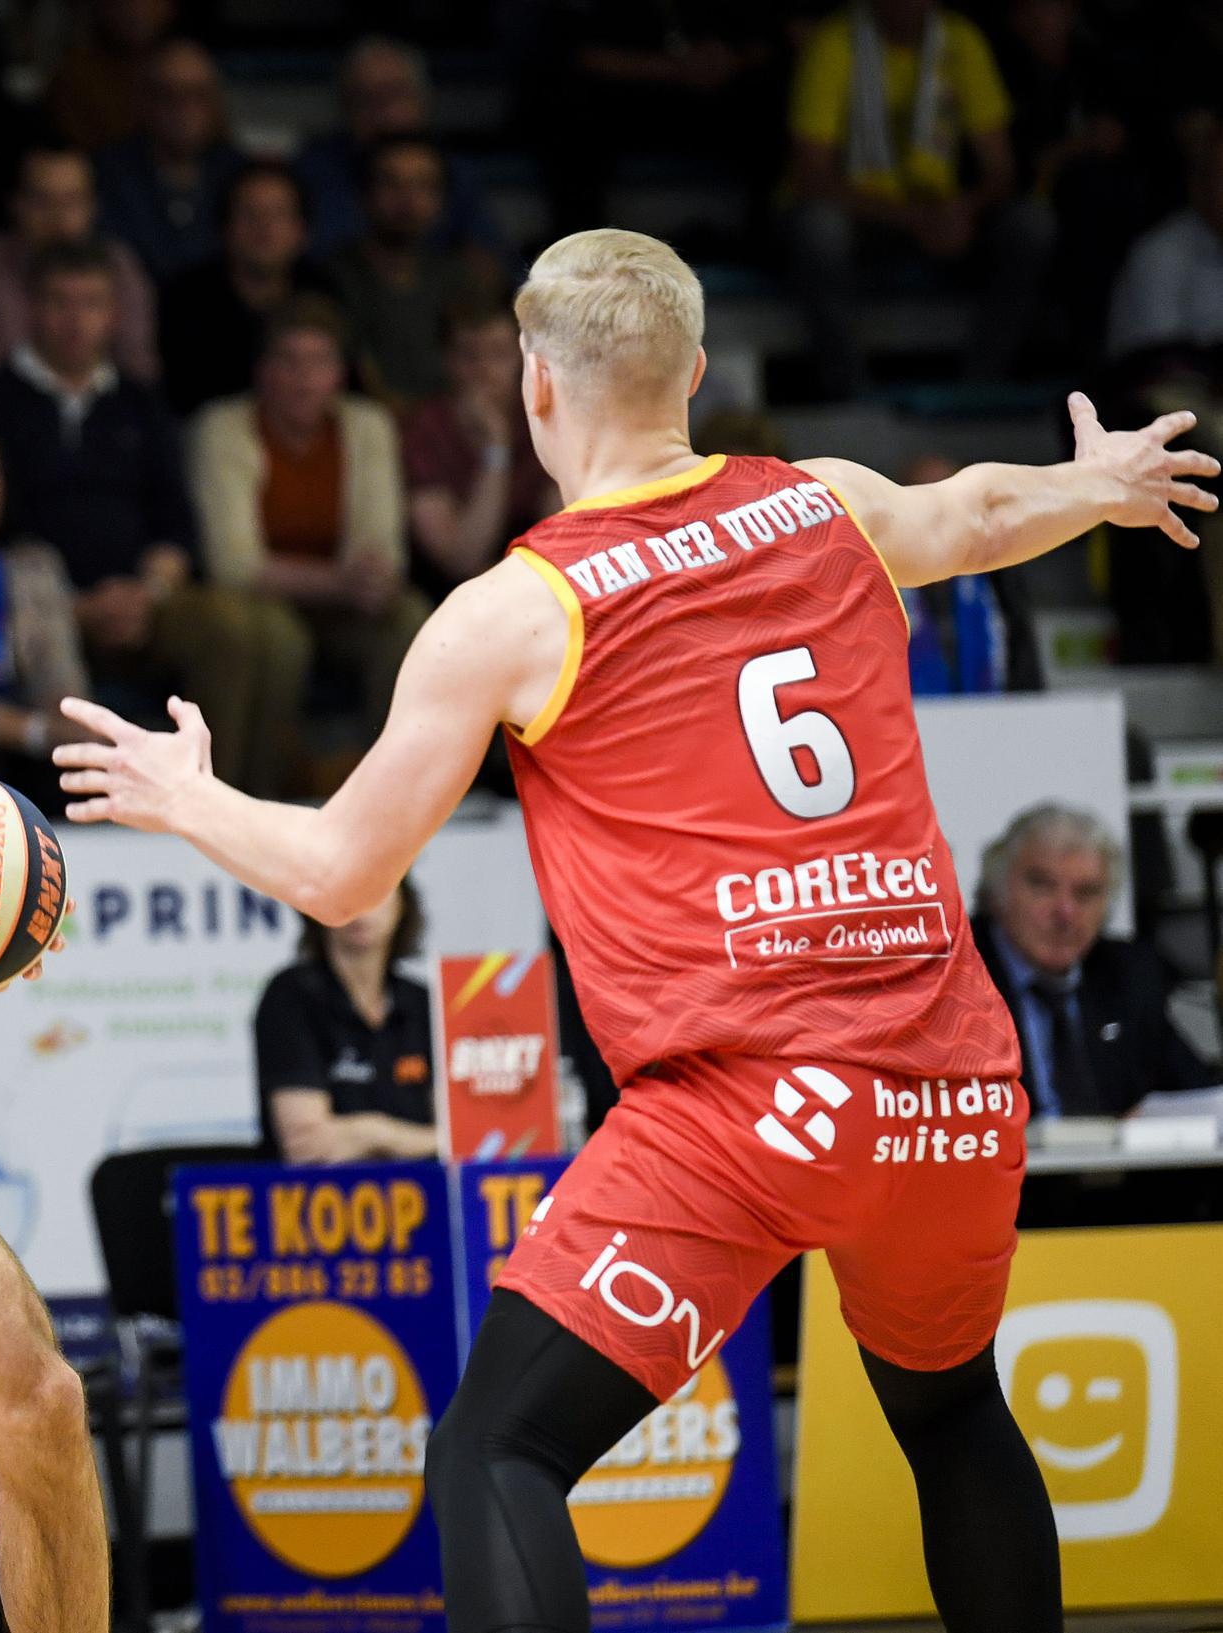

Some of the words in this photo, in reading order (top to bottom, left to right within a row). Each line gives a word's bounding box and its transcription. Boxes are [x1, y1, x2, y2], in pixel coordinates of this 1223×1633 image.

[565, 542, 652, 598] VAN
[645, 520, 728, 573] DER
[715, 481, 846, 552] VUURST
[738, 646, 857, 820] 6
[715, 851, 938, 922] COREtec
[756, 929, 810, 957] the
[825, 915, 928, 956] Original
[873, 1077, 1014, 1119] holiday
[872, 1125, 1000, 1163] suites
[192, 1182, 256, 1258] TE
[270, 1178, 427, 1256] KOOP
[247, 1354, 399, 1413] IMMO
[210, 1414, 432, 1480] WALBERS
